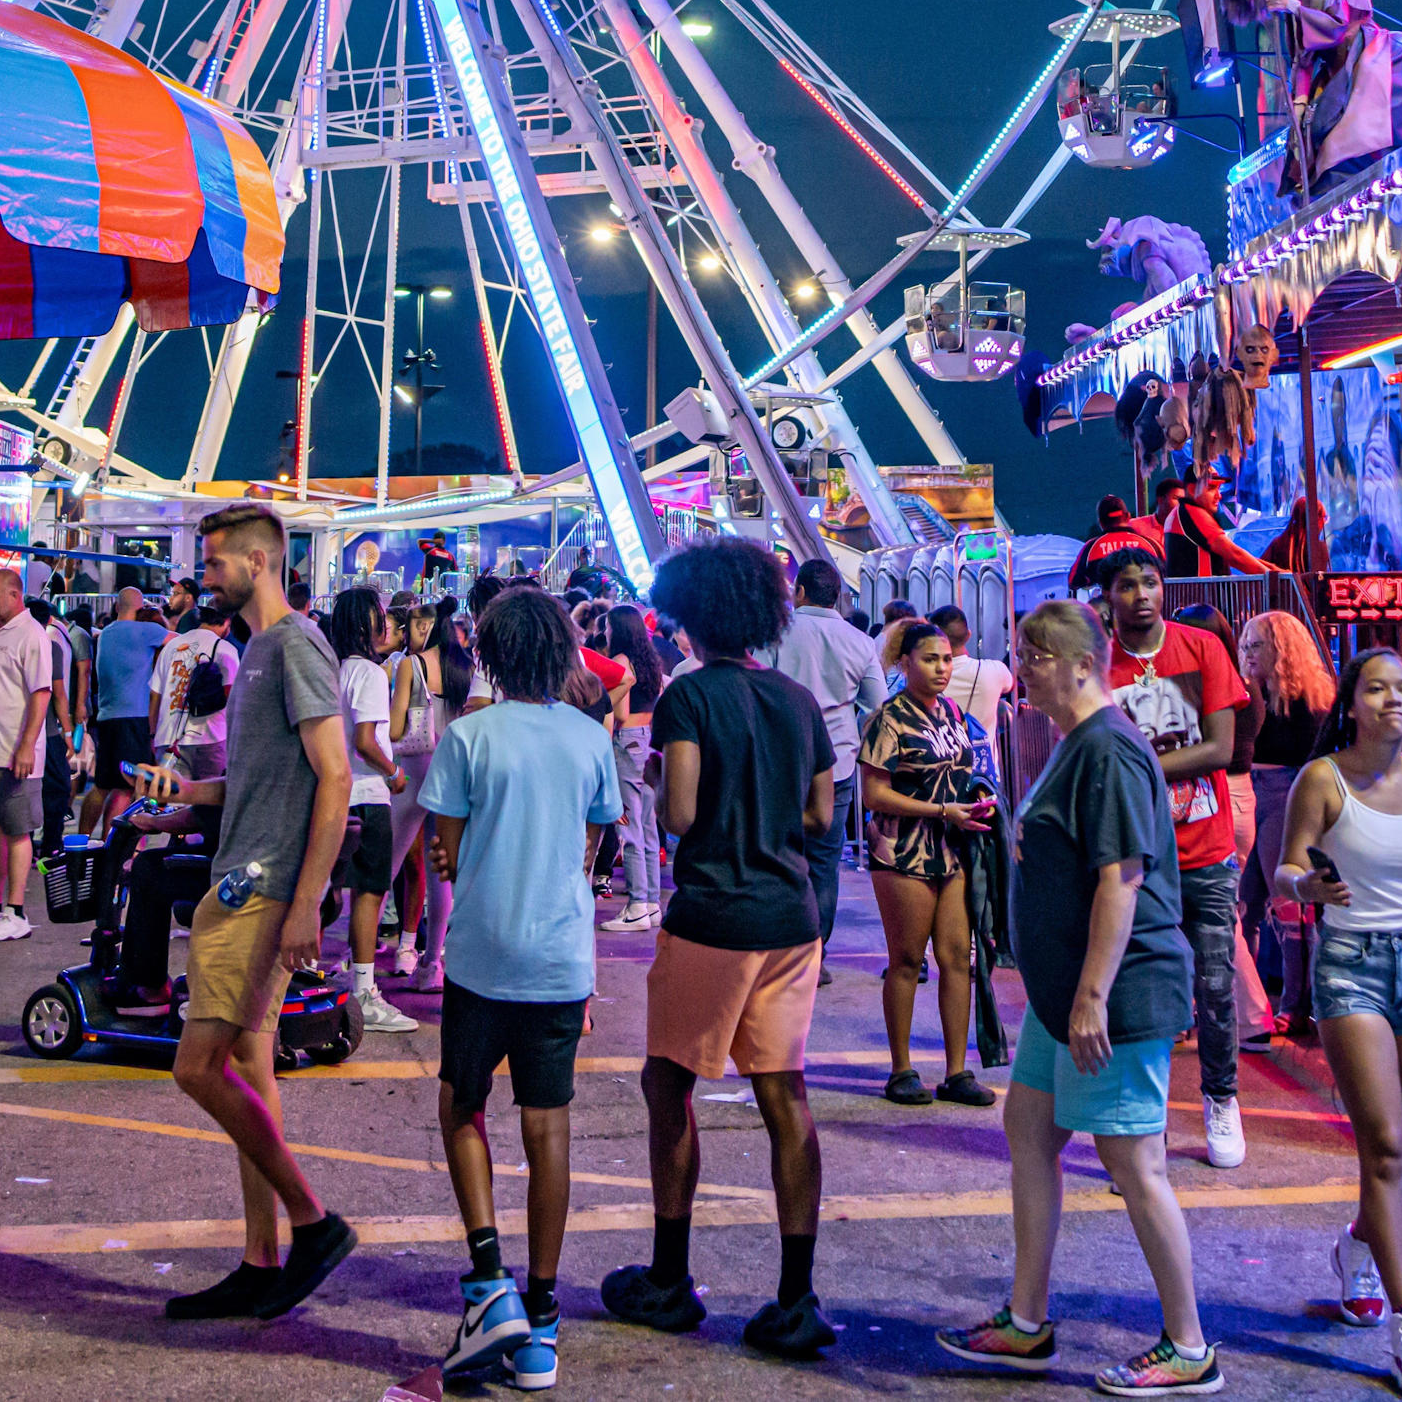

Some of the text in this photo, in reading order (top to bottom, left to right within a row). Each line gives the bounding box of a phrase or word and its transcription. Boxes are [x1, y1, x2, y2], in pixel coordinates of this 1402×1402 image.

[444, 14, 586, 398] WELCOME TO THE OHIO STATE FAIR
[609, 499, 655, 595] WELCO
